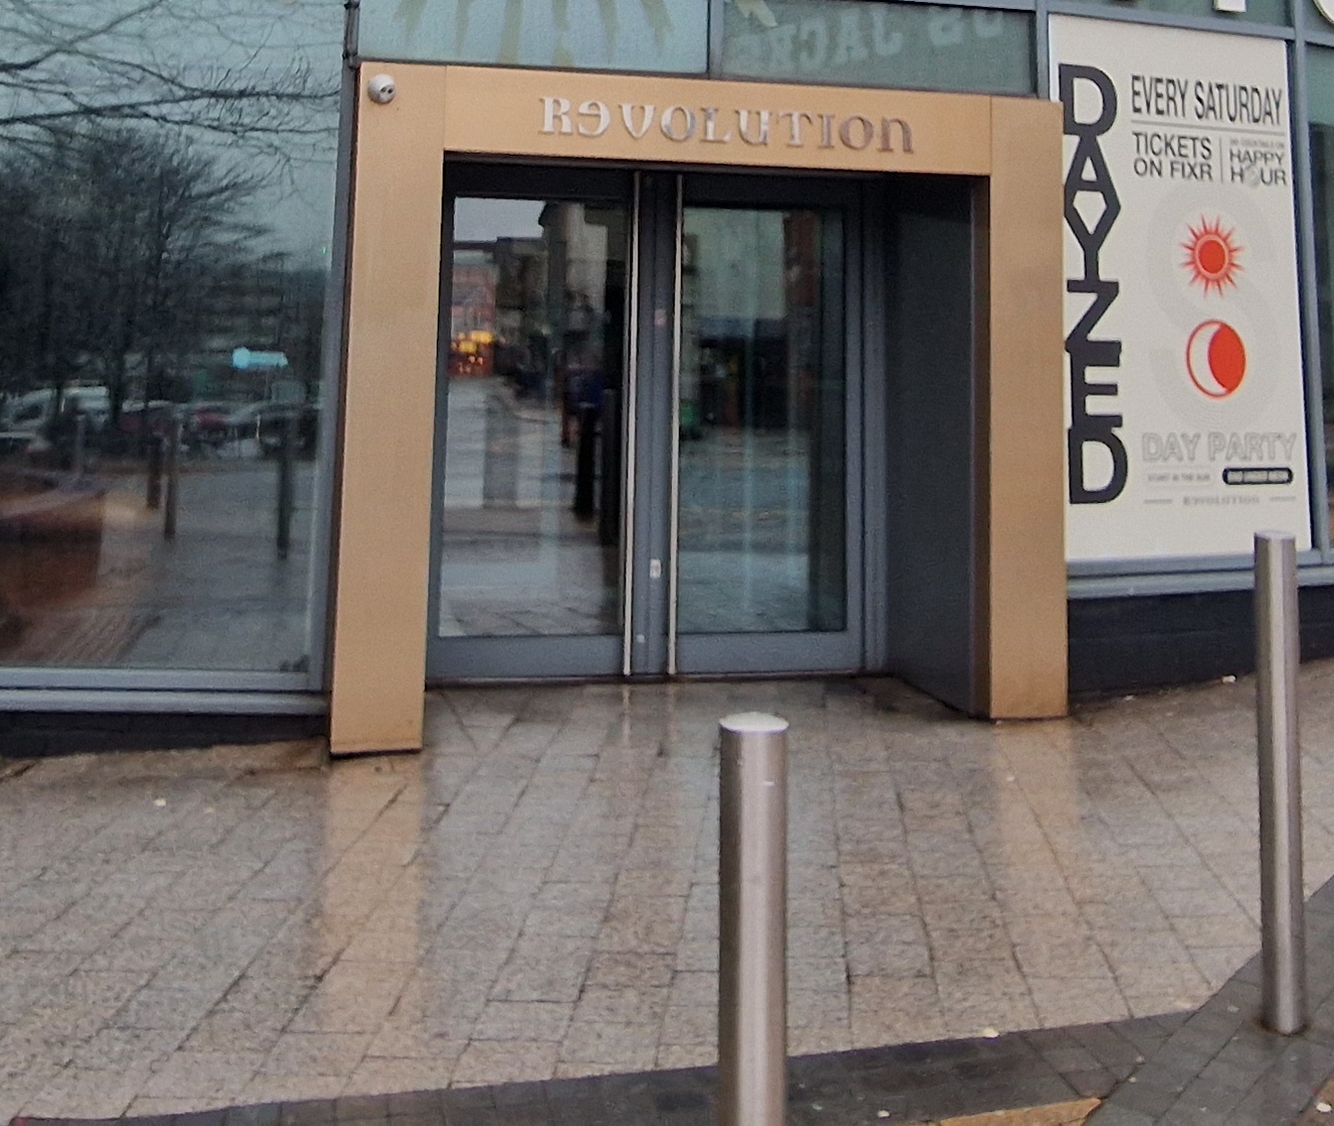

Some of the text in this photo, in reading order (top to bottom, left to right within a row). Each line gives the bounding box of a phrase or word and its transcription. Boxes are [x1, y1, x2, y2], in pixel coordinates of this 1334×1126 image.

[1130, 74, 1283, 126] EVERY SATURDAY
[1132, 131, 1213, 160] TICKETS
[1229, 148, 1285, 165] HAPPY
[1134, 158, 1213, 182] ON FIXR
[1058, 63, 1128, 504] DAYZED
[1142, 431, 1297, 462] DAY PARTY
